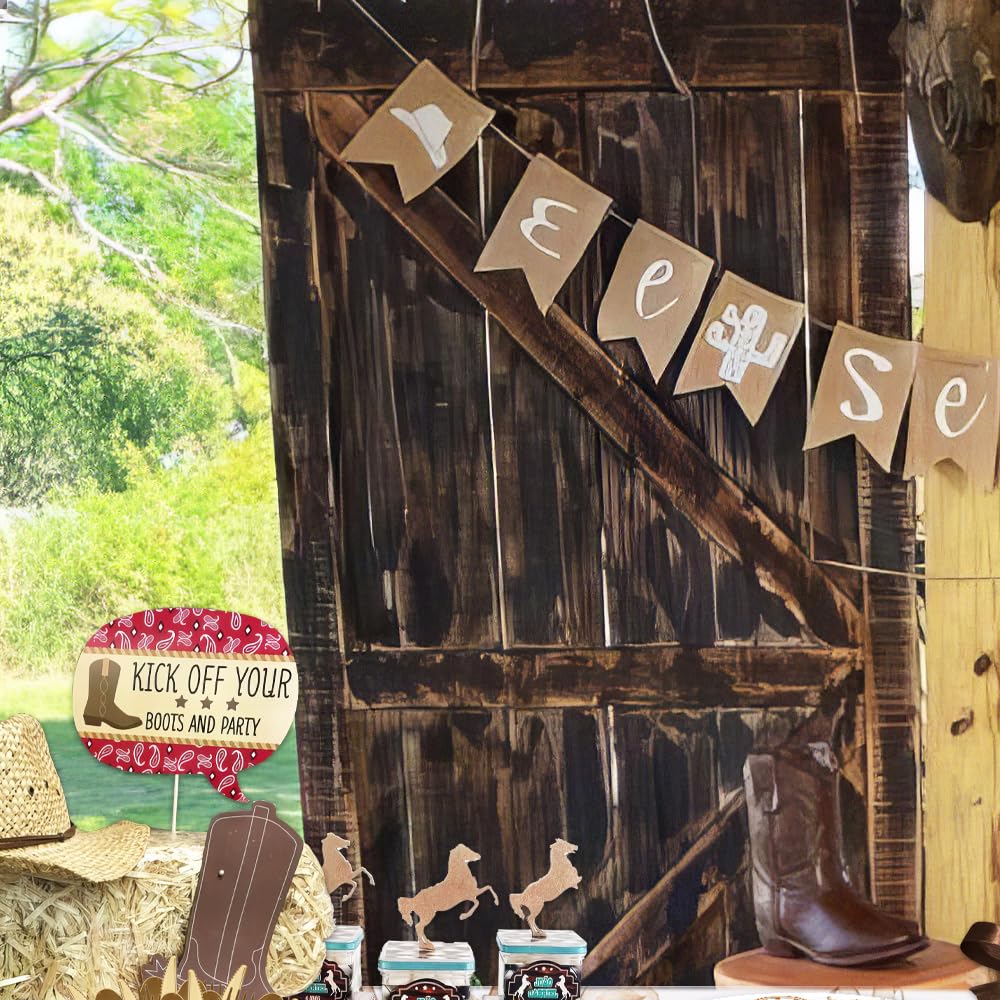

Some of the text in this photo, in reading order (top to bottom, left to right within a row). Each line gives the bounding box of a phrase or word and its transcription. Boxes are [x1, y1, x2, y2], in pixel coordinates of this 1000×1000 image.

[132, 661, 292, 699] KICK OFF YOUR
[145, 711, 261, 736] BOOTS AND PARTY
